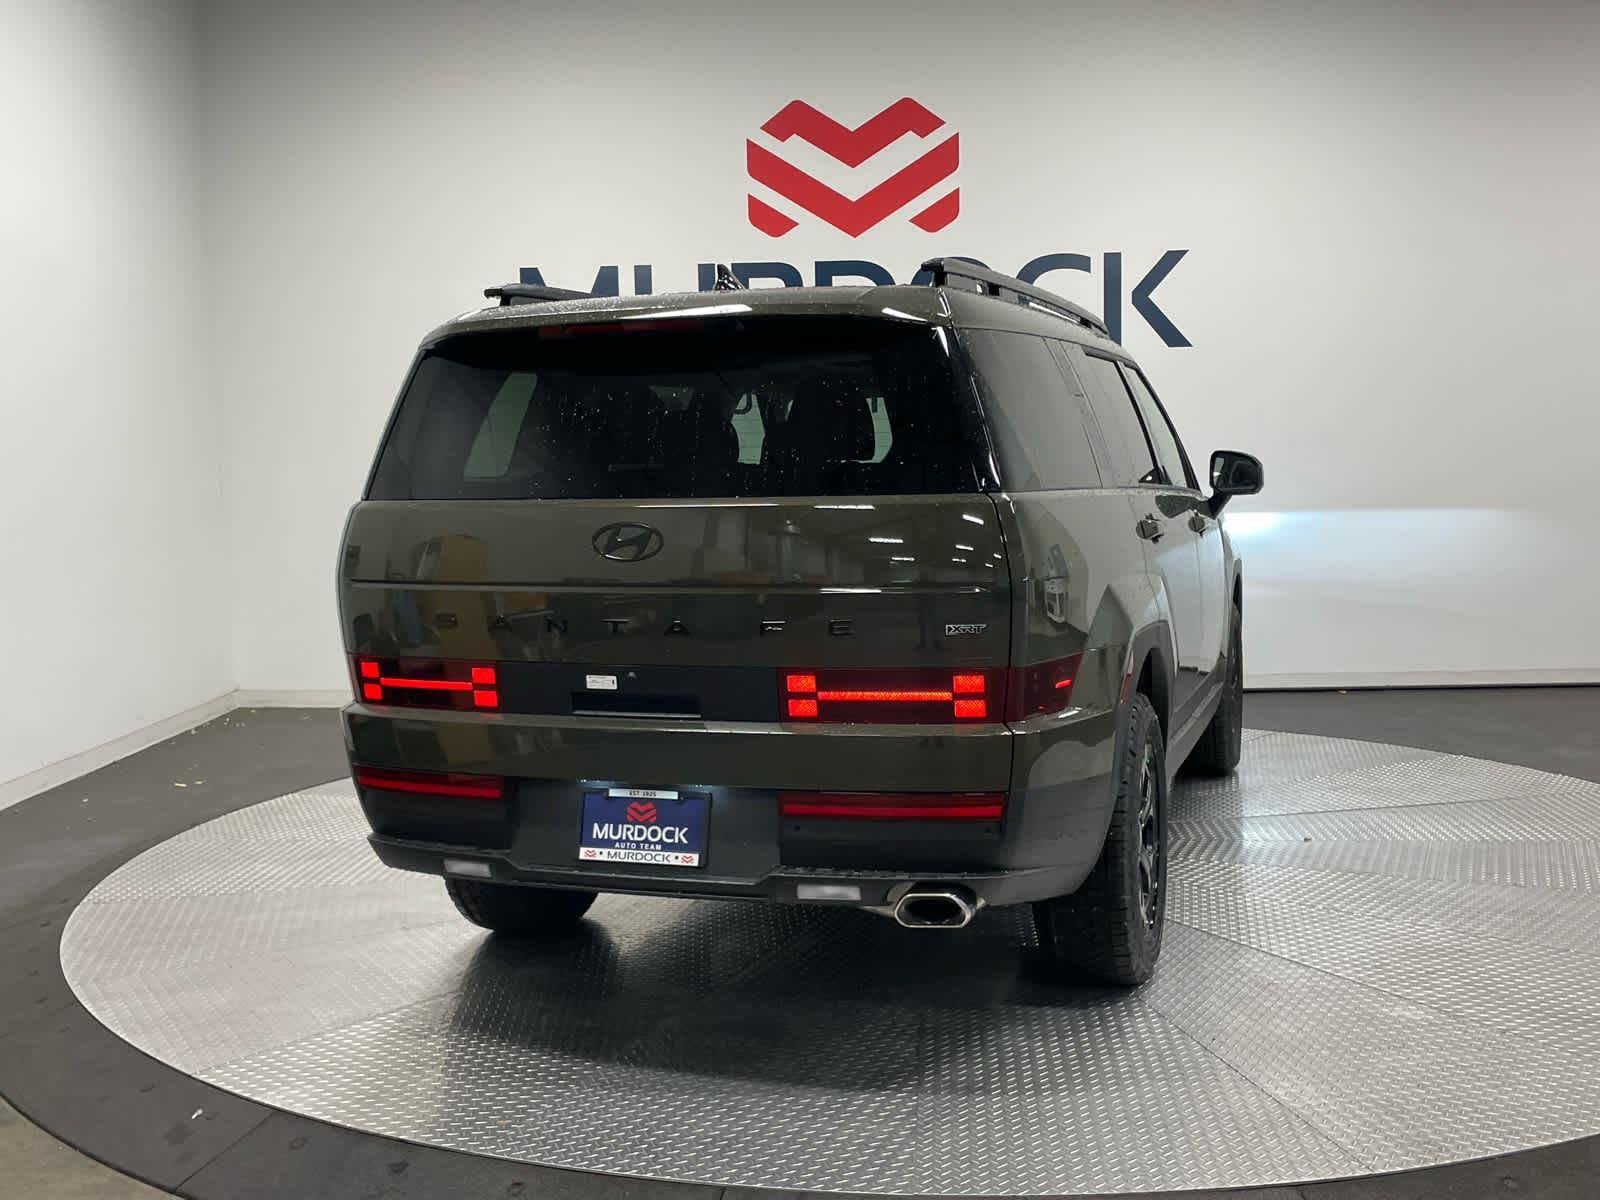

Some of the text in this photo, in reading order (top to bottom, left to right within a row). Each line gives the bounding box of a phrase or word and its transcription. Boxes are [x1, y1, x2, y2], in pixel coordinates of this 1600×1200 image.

[435, 613, 855, 637] SANTA FE
[945, 623, 987, 635] XRT
[592, 822, 688, 844] MURDOCK
[640, 842, 662, 850] TEAM
[607, 850, 671, 863] MURDOCK
